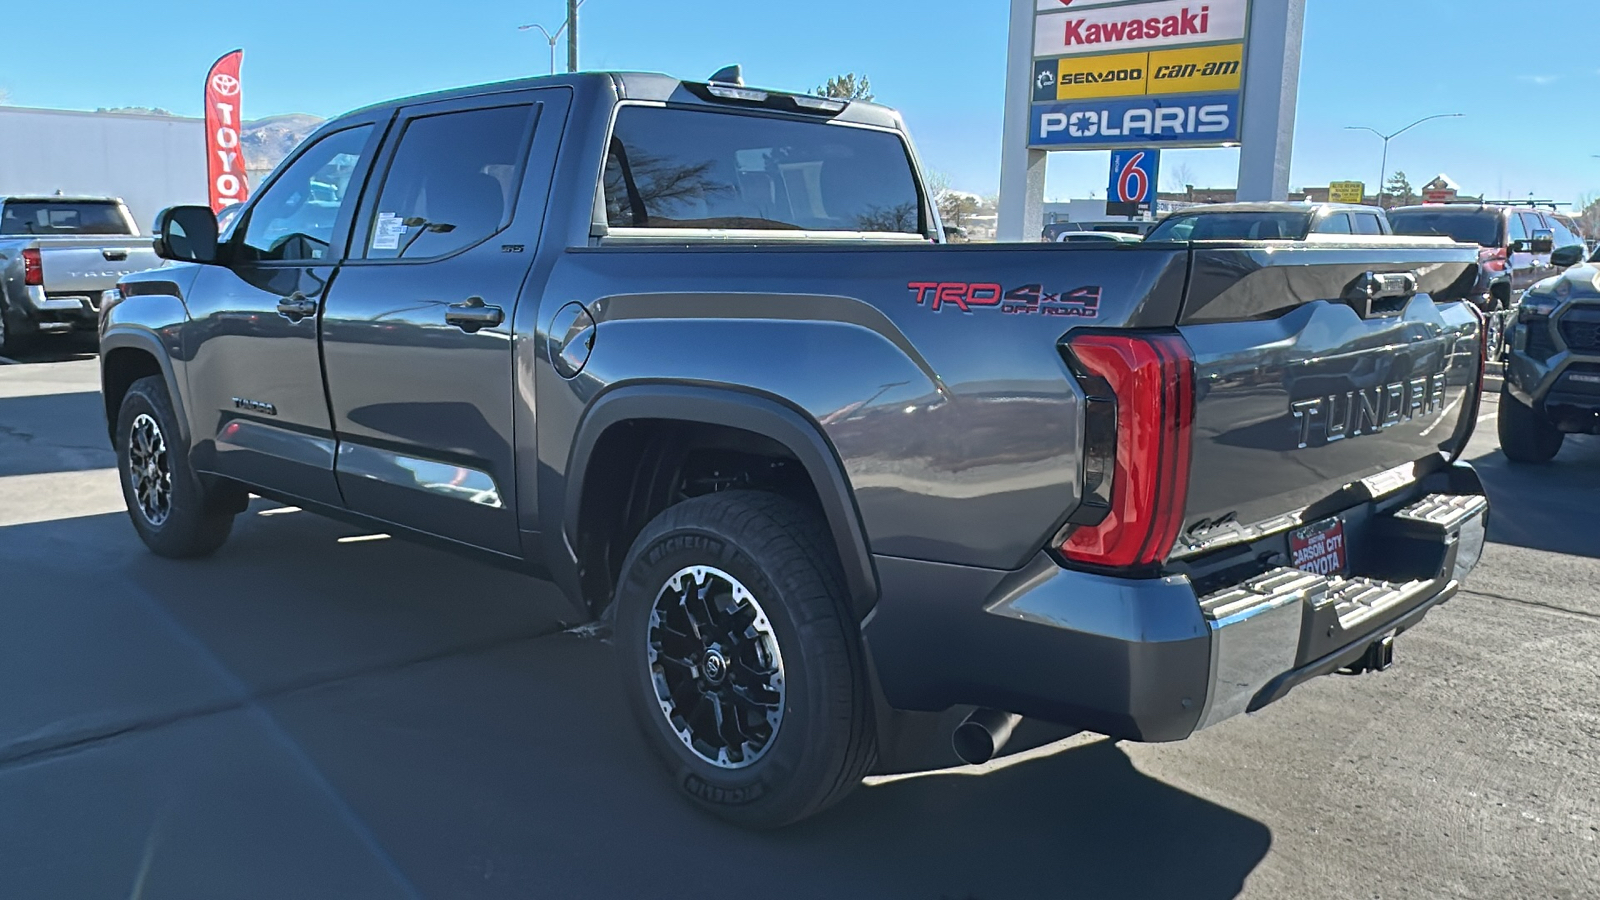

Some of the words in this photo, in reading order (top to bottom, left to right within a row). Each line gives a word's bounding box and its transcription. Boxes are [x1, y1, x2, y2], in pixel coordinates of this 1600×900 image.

[1064, 6, 1209, 46] Kawasaki
[1154, 60, 1239, 80] can-am
[1040, 104, 1230, 138] POLARIS
[217, 103, 241, 220] TOYOT
[1117, 152, 1149, 202] 6
[907, 281, 1003, 314] TRD
[1001, 306, 1039, 315] OFF
[1041, 306, 1098, 318] ROAD
[1290, 373, 1447, 449] TUNDRA
[1326, 533, 1342, 552] CITY
